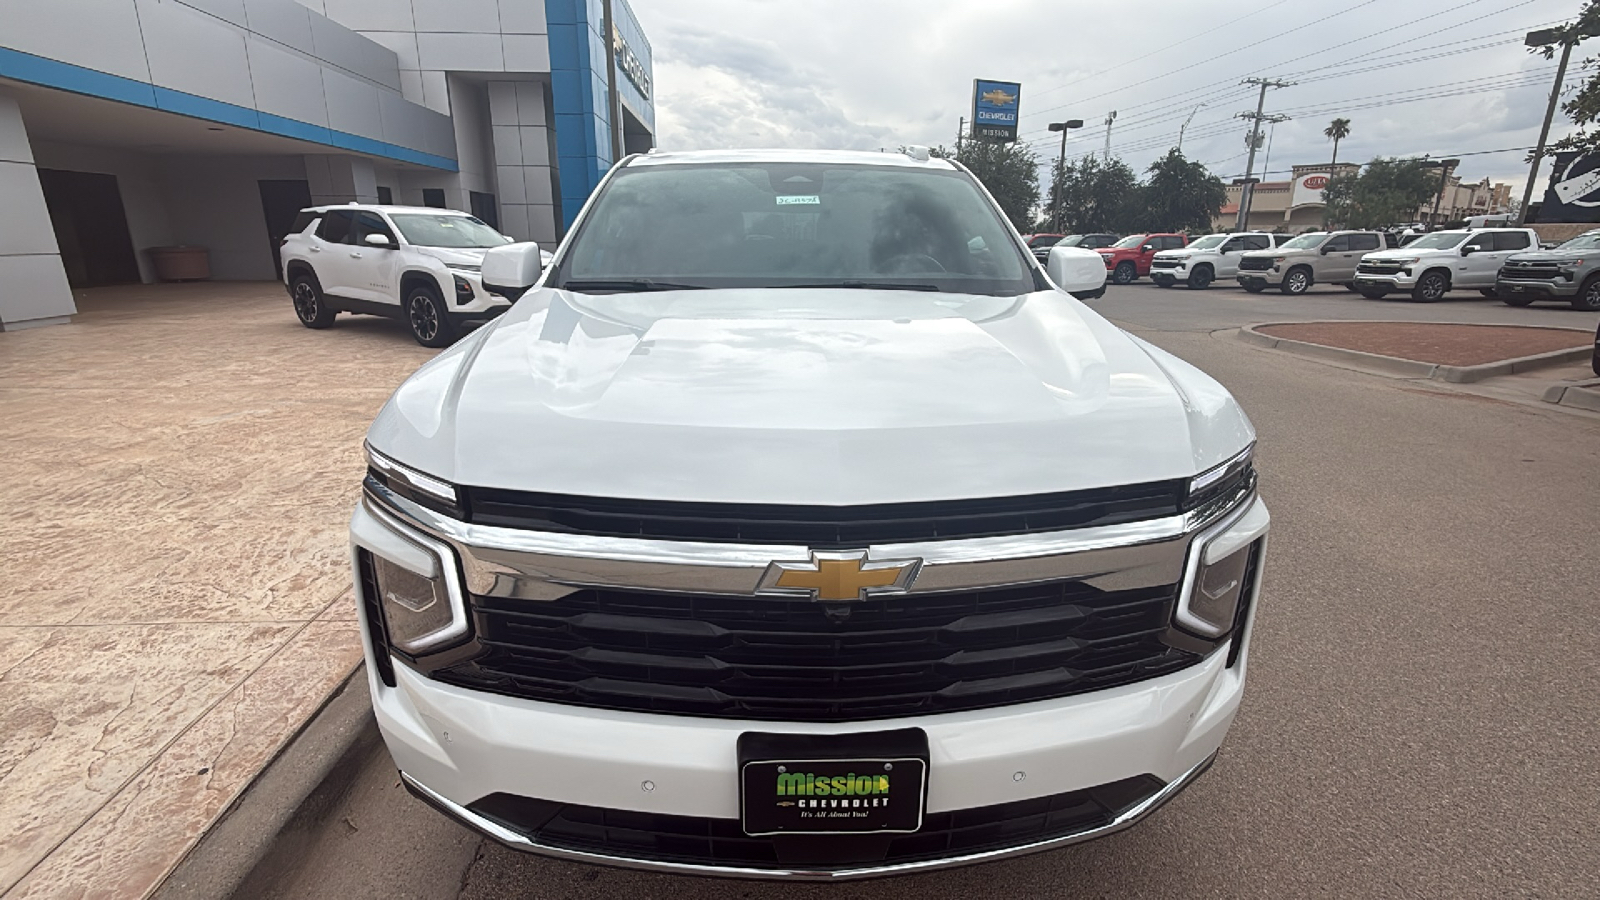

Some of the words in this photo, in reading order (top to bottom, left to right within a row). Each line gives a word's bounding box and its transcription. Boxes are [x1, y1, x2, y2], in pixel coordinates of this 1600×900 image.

[979, 112, 1014, 120] CHEVROLET
[983, 129, 1009, 137] MISSION
[777, 772, 889, 796] Mission
[798, 798, 889, 808] CHEVROLET
